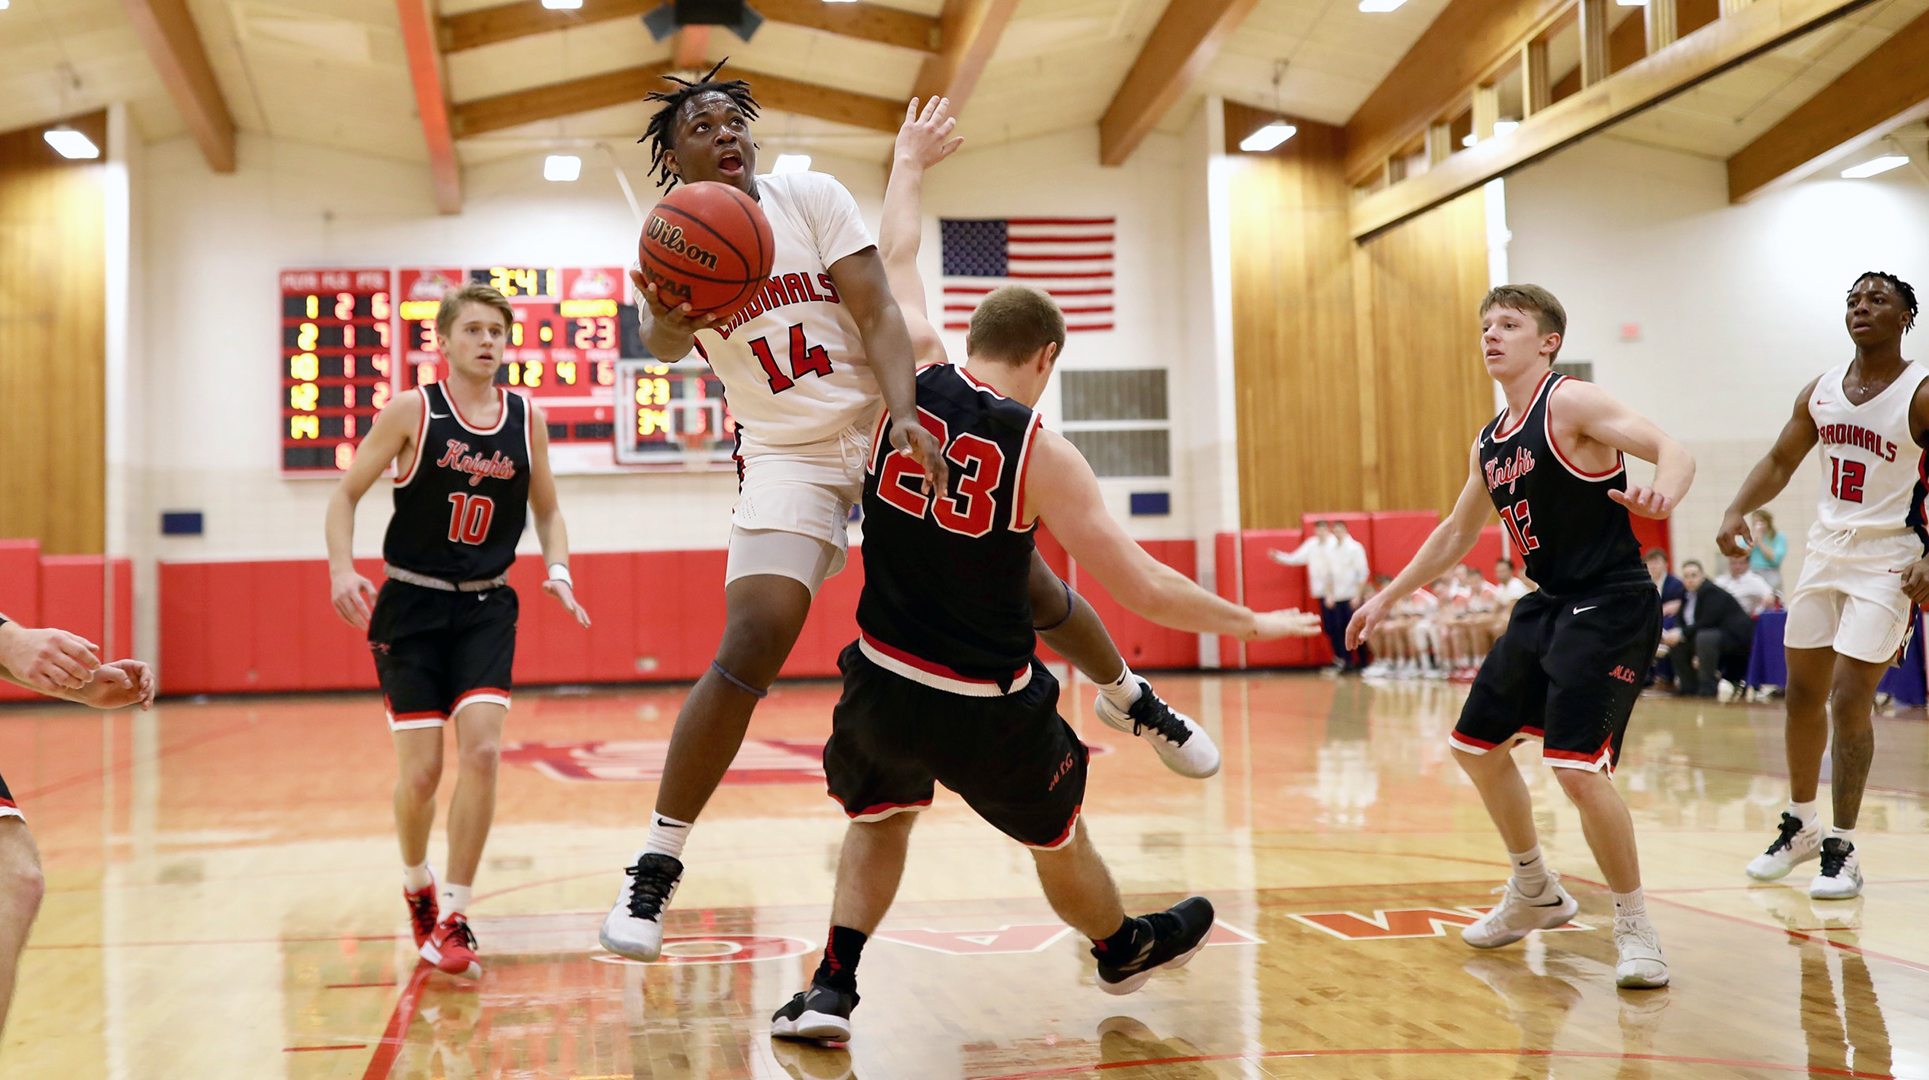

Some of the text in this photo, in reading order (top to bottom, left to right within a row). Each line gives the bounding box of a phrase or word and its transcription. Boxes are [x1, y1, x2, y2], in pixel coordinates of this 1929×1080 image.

[646, 213, 719, 272] Wilson
[490, 267, 556, 297] 3:41
[306, 295, 319, 319] 1
[335, 292, 355, 320] 2
[371, 292, 392, 320] 6
[298, 323, 319, 351] 2
[344, 324, 356, 348] 1
[574, 318, 616, 349] 23
[344, 354, 356, 378] 1
[509, 360, 576, 388] 12 4
[747, 322, 834, 395] 14
[344, 384, 356, 408] 1
[344, 414, 356, 439] 1
[1817, 424, 1898, 463] ARDINALS
[436, 438, 515, 486] Knights
[876, 405, 1005, 538] 23
[1829, 456, 1866, 504] 12
[447, 491, 495, 546] 10
[1500, 499, 1540, 555] 12
